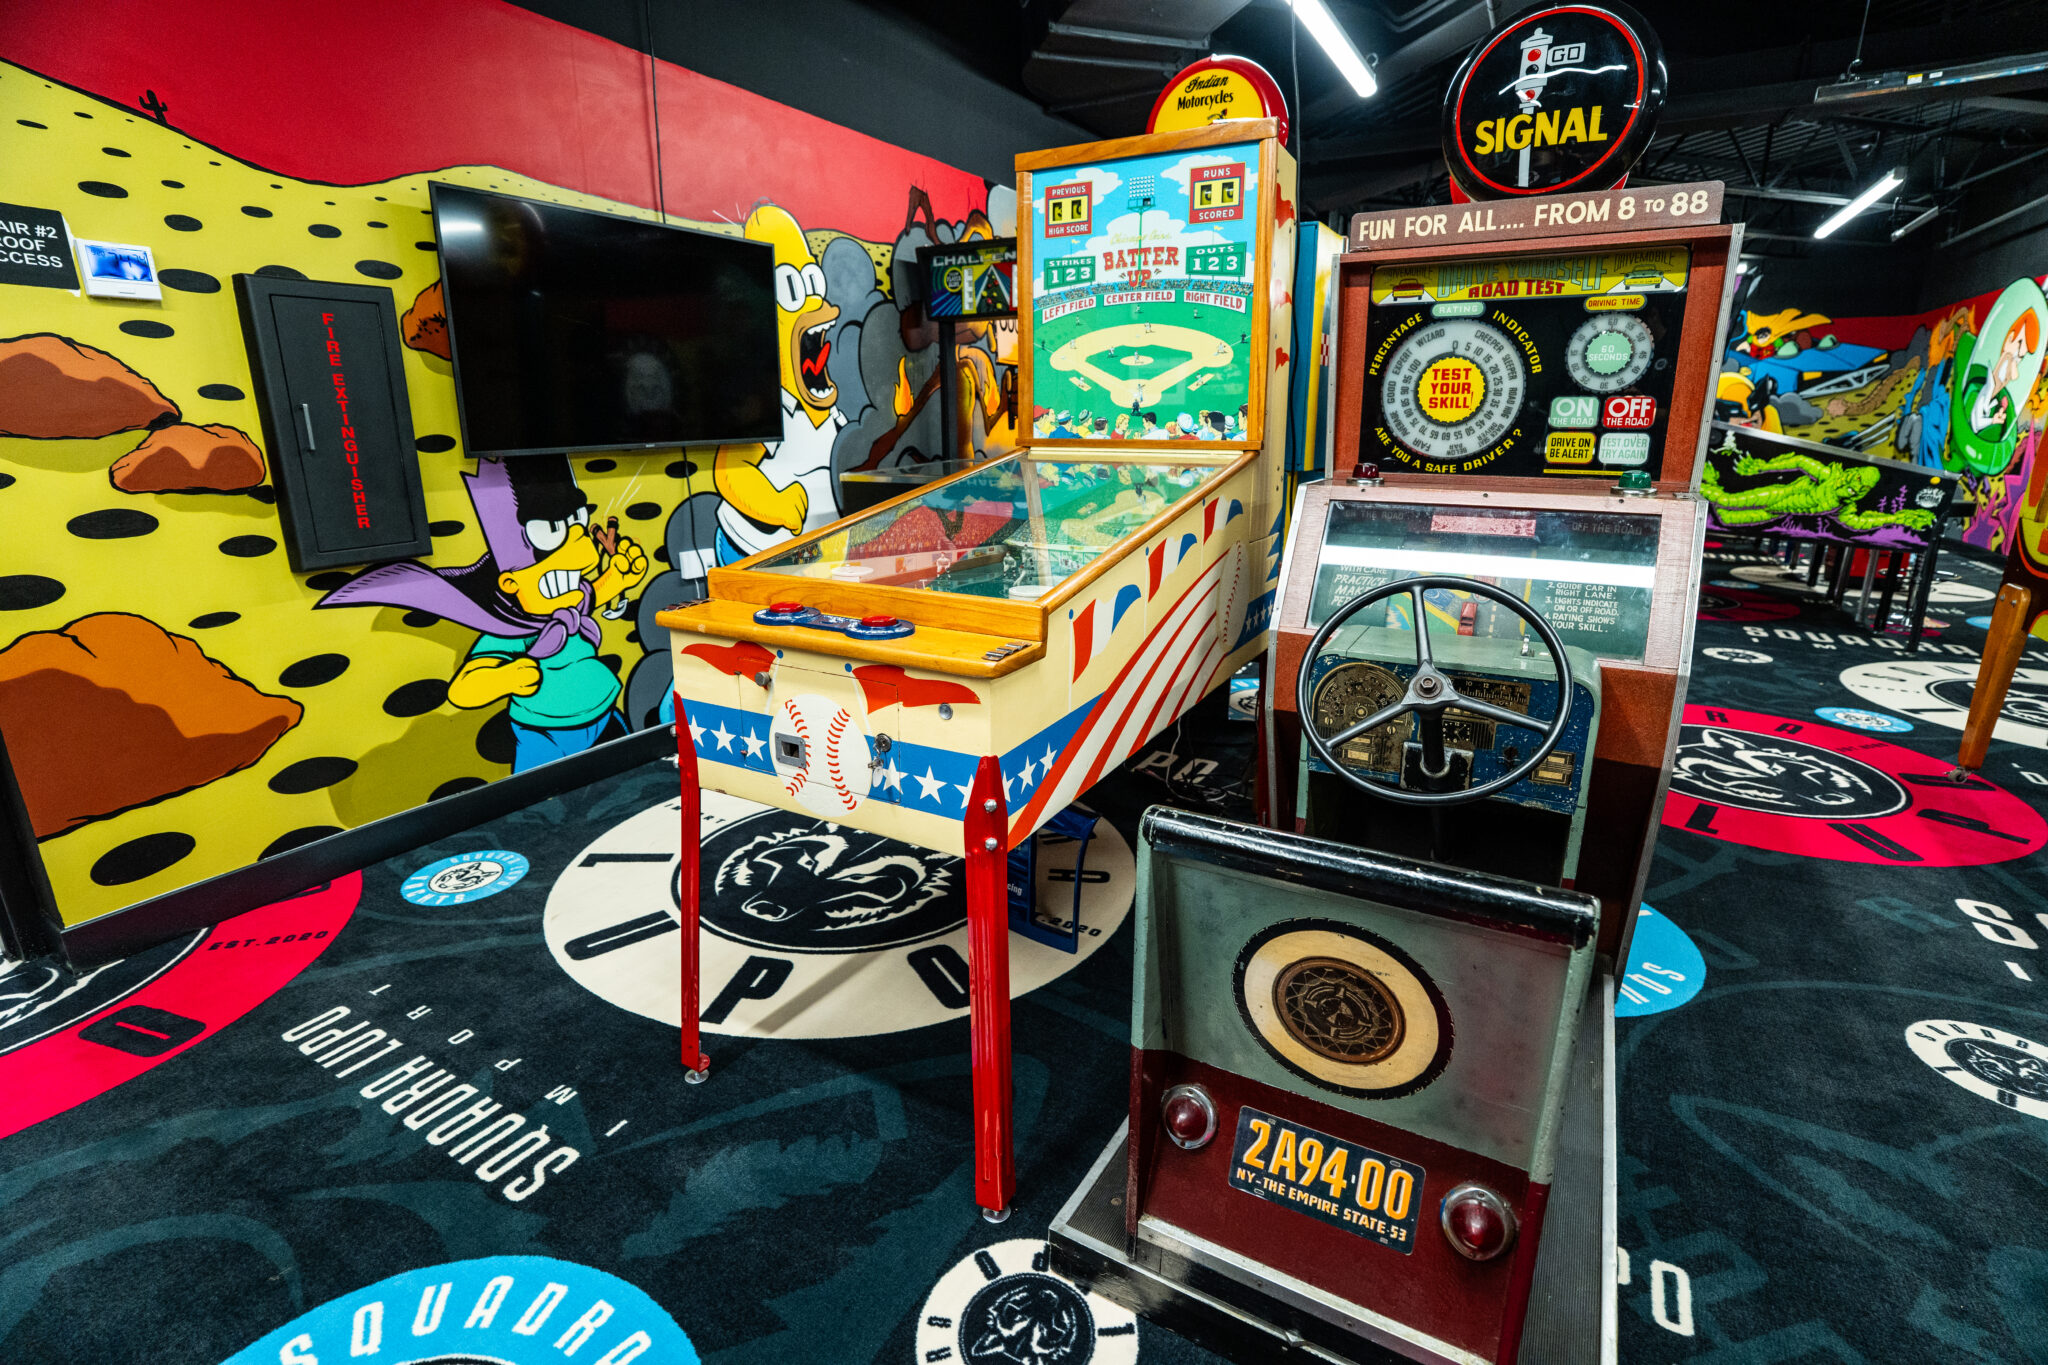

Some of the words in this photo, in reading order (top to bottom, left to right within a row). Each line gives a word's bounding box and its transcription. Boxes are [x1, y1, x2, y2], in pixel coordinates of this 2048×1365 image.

[1552, 46, 1581, 63] GO
[1185, 74, 1229, 93] Indian
[1177, 90, 1234, 110] Motorcycles
[1474, 106, 1608, 155] SIGNAL
[1203, 168, 1231, 178] RUNS
[1052, 185, 1086, 196] PREVIOUS
[1199, 209, 1235, 220] SCORED
[1358, 218, 1396, 242] FUN
[1404, 214, 1448, 238] FOR
[1533, 199, 1610, 228] FROM
[1618, 196, 1636, 220] 8
[1644, 198, 1665, 212] TO
[1670, 190, 1710, 216] 88
[34, 224, 58, 239] #2
[1049, 227, 1064, 235] HIGH
[1066, 224, 1088, 234] SCORE
[1196, 246, 1234, 254] OUTS
[1049, 258, 1092, 266] STRIKES
[1102, 246, 1180, 271] BATTER
[1192, 258, 1202, 270] 1
[1208, 257, 1220, 270] 2
[1226, 256, 1238, 270] 3
[1052, 270, 1060, 283] 1
[1066, 269, 1076, 282] 2
[1080, 268, 1091, 280] 3
[1436, 262, 1500, 298] DRIVE
[1504, 254, 1610, 292] YOURSELF
[1468, 279, 1522, 298] ROAD
[1524, 279, 1566, 296] TEST
[1106, 293, 1142, 304] CENTER
[1145, 292, 1173, 302] FIELD
[1186, 292, 1212, 304] RIGHT
[1214, 295, 1243, 310] FIELD
[1588, 298, 1617, 307] DRIVING
[1622, 298, 1641, 306] TIME
[1044, 305, 1066, 320] LEFT
[1070, 298, 1094, 312] FIELD
[1439, 305, 1478, 314] RATING
[1369, 312, 1424, 376] PERCENTAGE
[1492, 309, 1543, 374] INDICATOR
[1416, 328, 1445, 348] WIZARD
[1474, 329, 1504, 354] CREEPER
[1452, 340, 1458, 350] 0
[1464, 342, 1471, 352] 5
[1601, 344, 1615, 353] 60
[1472, 346, 1484, 356] 10
[1392, 348, 1412, 376] EXPERT
[1482, 353, 1492, 364] 15
[1589, 352, 1629, 362] SECONDS
[1408, 358, 1422, 372] 100
[1489, 364, 1500, 375] 20
[1402, 374, 1412, 384] 95
[1432, 368, 1472, 380] TEST
[1493, 376, 1504, 386] 25
[1386, 380, 1397, 404] GOOD
[1400, 386, 1410, 396] 90
[1430, 382, 1472, 394] YOUR
[1492, 388, 1502, 397] 30
[1400, 397, 1410, 407] 85
[1490, 398, 1500, 408] 35
[1556, 398, 1594, 417] ON
[1404, 408, 1414, 419] 80
[1608, 398, 1652, 418] OFF
[1484, 410, 1494, 420] 40
[321, 312, 342, 367] FIRE
[332, 373, 372, 530] EXTINGUISHER
[1410, 418, 1420, 428] 75
[1475, 418, 1486, 428] 45
[1552, 417, 1567, 426] THE
[1570, 417, 1595, 426] ROAD
[1606, 417, 1624, 426] THE
[1624, 417, 1650, 426] ROAD
[1418, 425, 1428, 436] 70
[1430, 430, 1439, 440] 65
[1454, 430, 1463, 440] 55
[1464, 426, 1476, 436] 50
[1442, 432, 1451, 441] 60
[1412, 437, 1432, 452] FAIR
[1551, 438, 1576, 448] DRIVE
[1578, 438, 1591, 448] ON
[1602, 438, 1622, 446] TEST
[1624, 438, 1648, 448] OVER
[1374, 426, 1392, 446] ARE
[1391, 444, 1411, 464] YOU
[1412, 460, 1421, 469] A
[1425, 463, 1457, 474] SAFE
[1463, 439, 1514, 471] DRIVER
[1512, 428, 1522, 438] ?
[1550, 448, 1560, 458] BE
[1562, 448, 1590, 458] ALERT
[1601, 449, 1618, 458] TRY
[1619, 449, 1646, 460] AGAIN
[1556, 582, 1582, 590] GUIDE
[1585, 584, 1604, 592] CAR
[1554, 597, 1581, 605] LIGHTS
[1582, 600, 1618, 608] INDICATE
[1552, 613, 1584, 622] RATING
[1586, 616, 1616, 624] SHOWS
[1552, 620, 1574, 630] YOUR
[1008, 882, 1023, 896] cing
[360, 1055, 581, 1202] SQUADRA
[1288, 1187, 1340, 1216] EMPIRE
